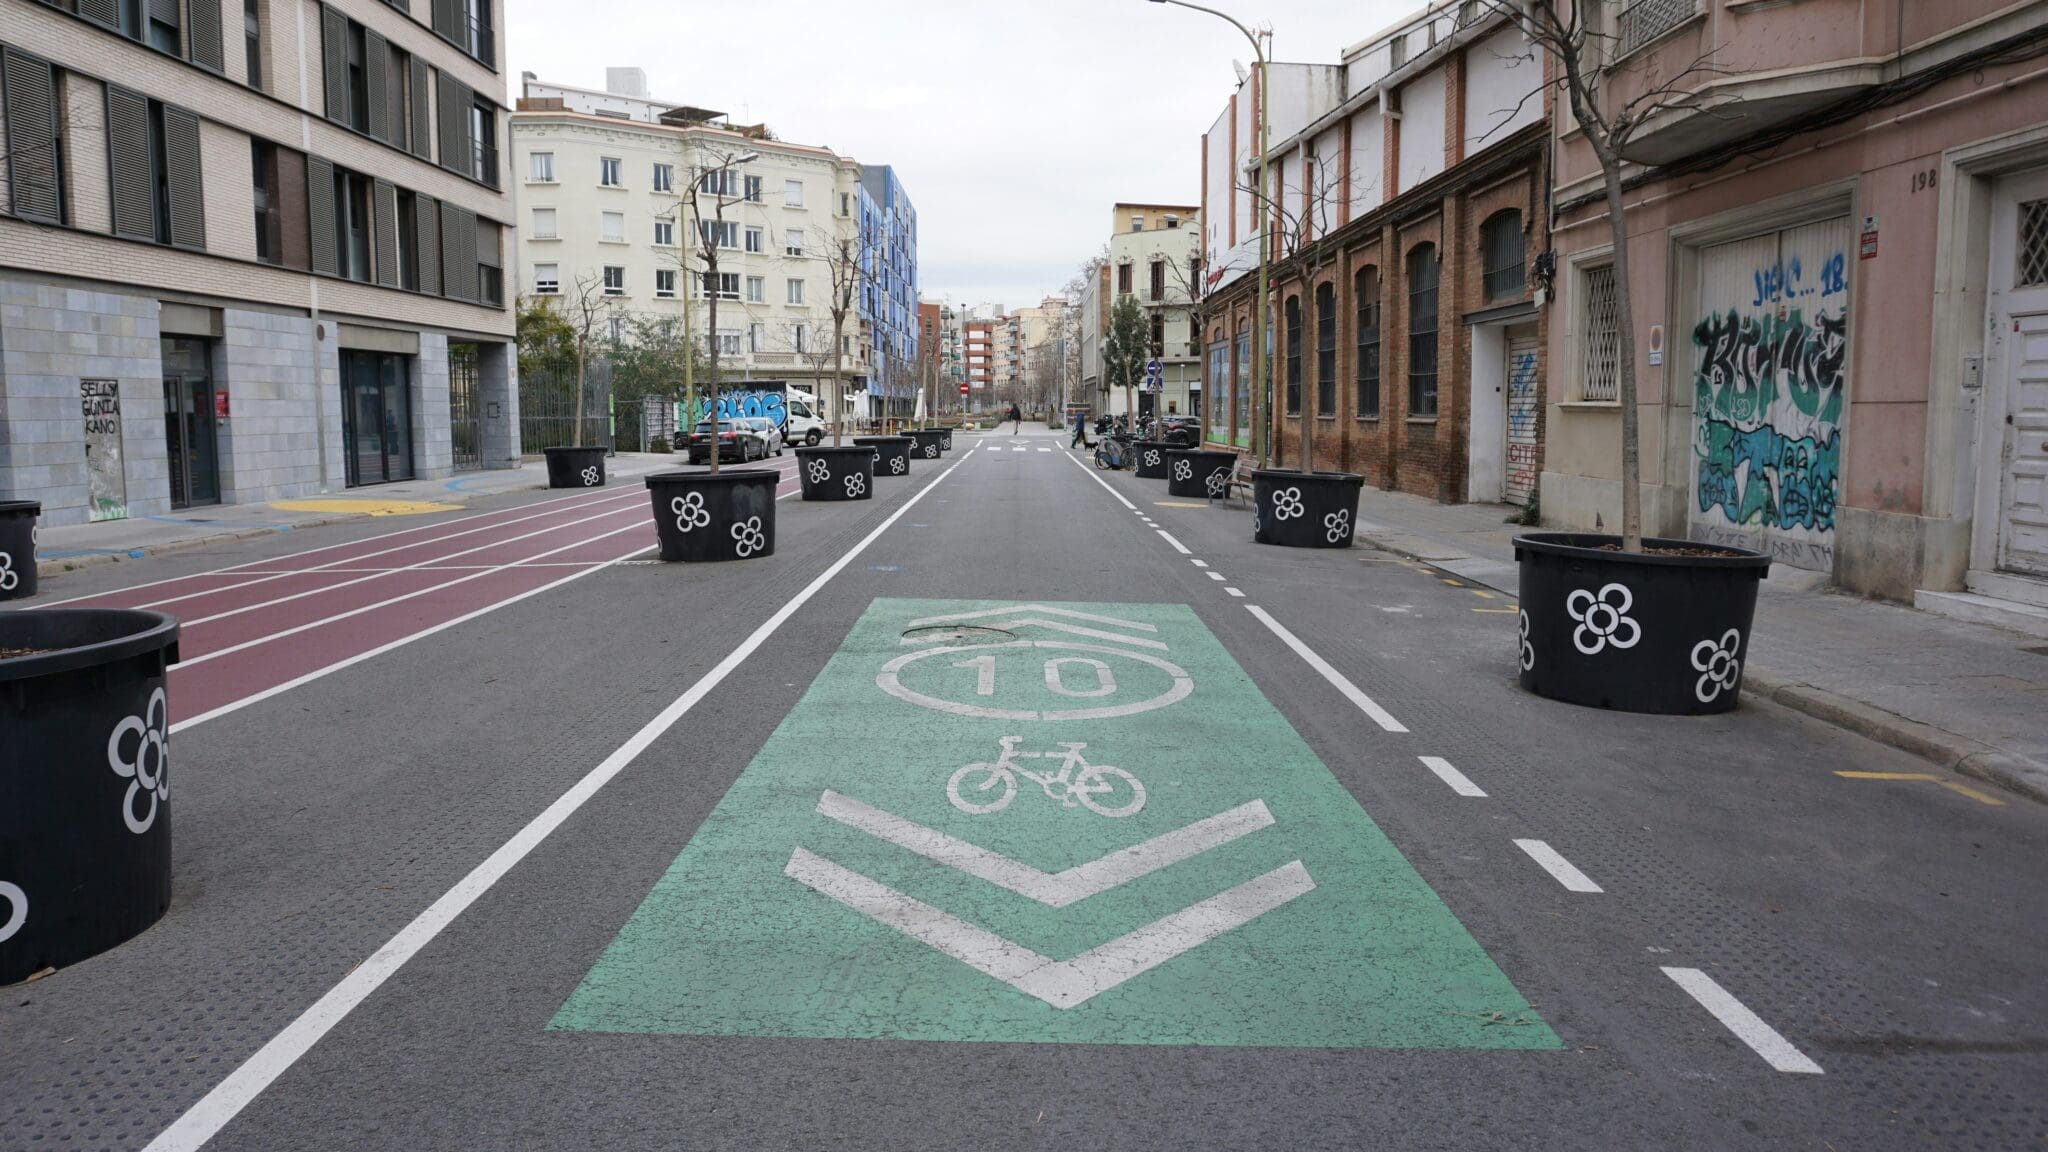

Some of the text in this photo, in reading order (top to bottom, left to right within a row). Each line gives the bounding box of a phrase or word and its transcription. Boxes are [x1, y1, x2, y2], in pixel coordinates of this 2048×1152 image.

[1911, 169, 1937, 192] 198
[81, 382, 118, 398] SELLY
[85, 419, 115, 435] KANO
[951, 655, 1117, 697] 10
